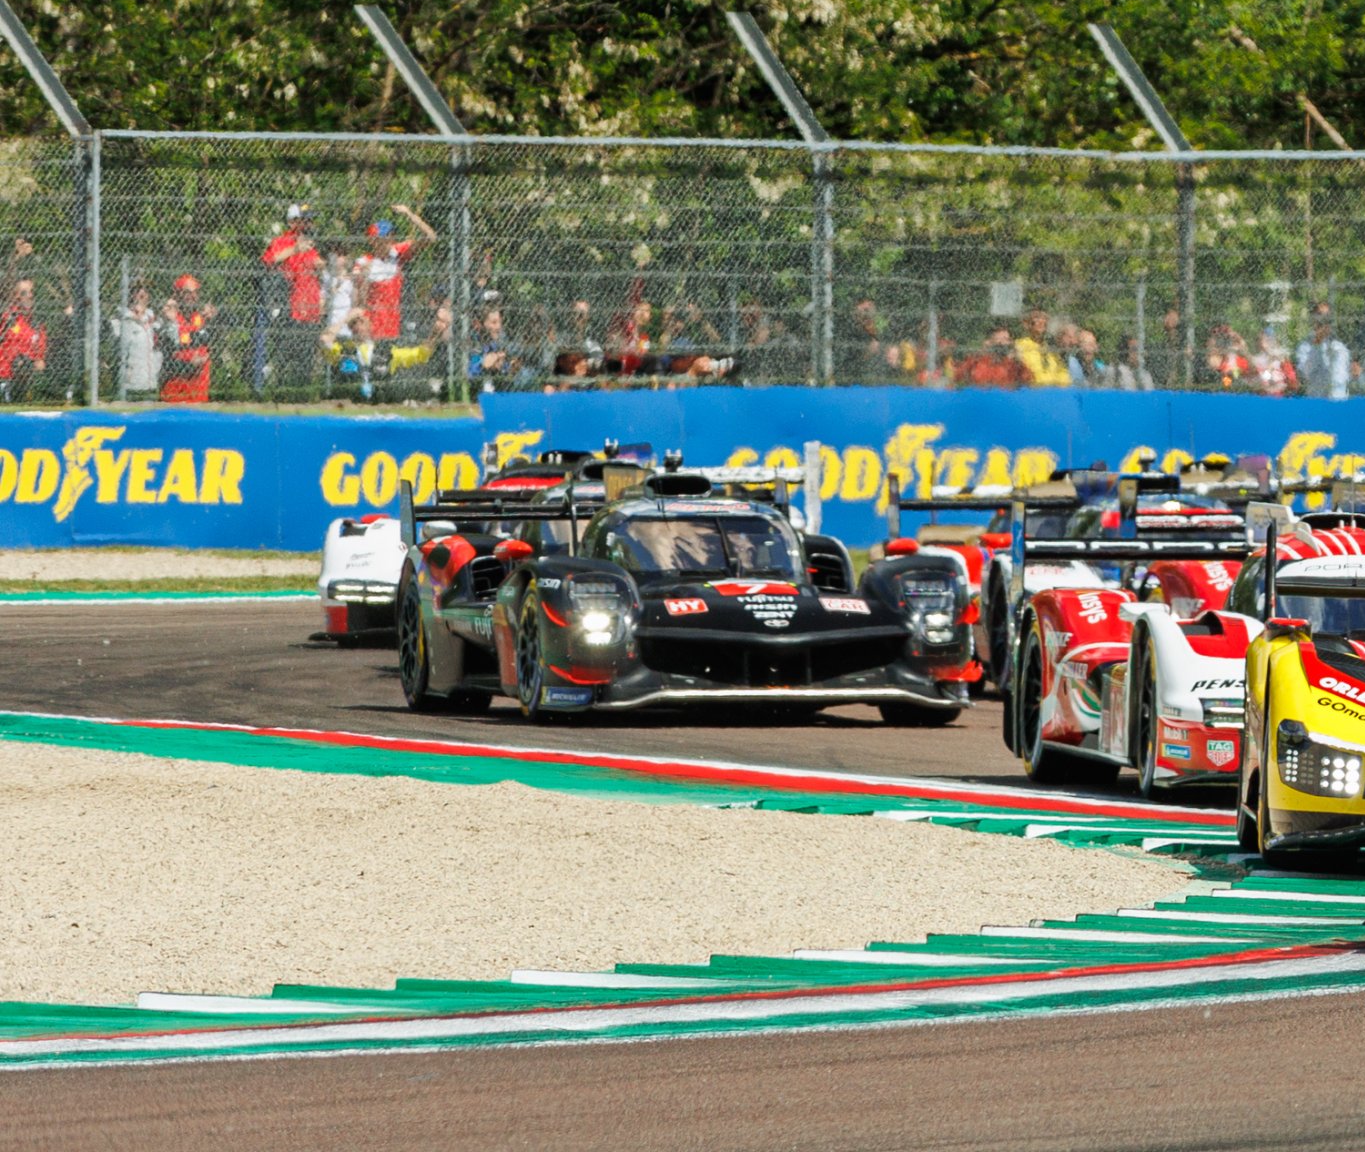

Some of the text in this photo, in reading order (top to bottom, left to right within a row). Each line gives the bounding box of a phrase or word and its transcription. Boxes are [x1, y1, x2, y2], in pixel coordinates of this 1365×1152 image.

[737, 583, 768, 594] 7
[668, 599, 700, 613] HY
[1208, 741, 1234, 751] TAG
